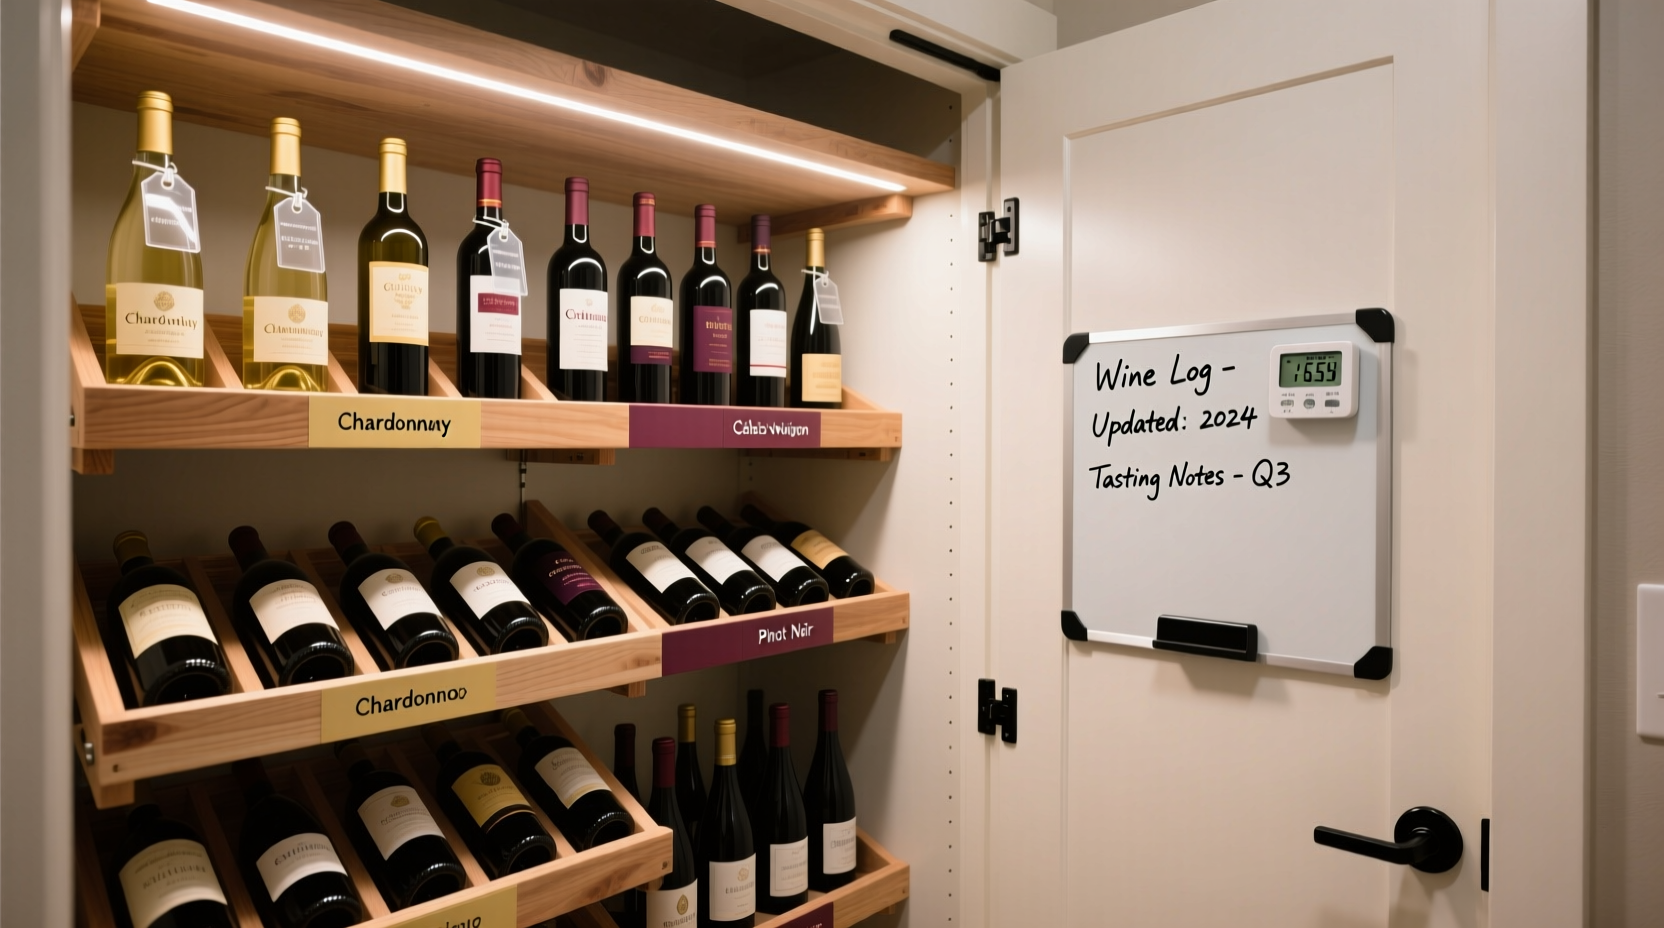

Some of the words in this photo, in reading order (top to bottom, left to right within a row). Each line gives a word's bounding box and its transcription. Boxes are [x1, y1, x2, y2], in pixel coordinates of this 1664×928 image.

[1096, 358, 1157, 392] Wine
[1169, 353, 1212, 396] Log
[1092, 406, 1187, 447] Updated:
[1199, 405, 1258, 430] 2024
[1088, 463, 1161, 501] Tasting
[1168, 461, 1225, 488] Notes
[1251, 458, 1291, 489] Q3
